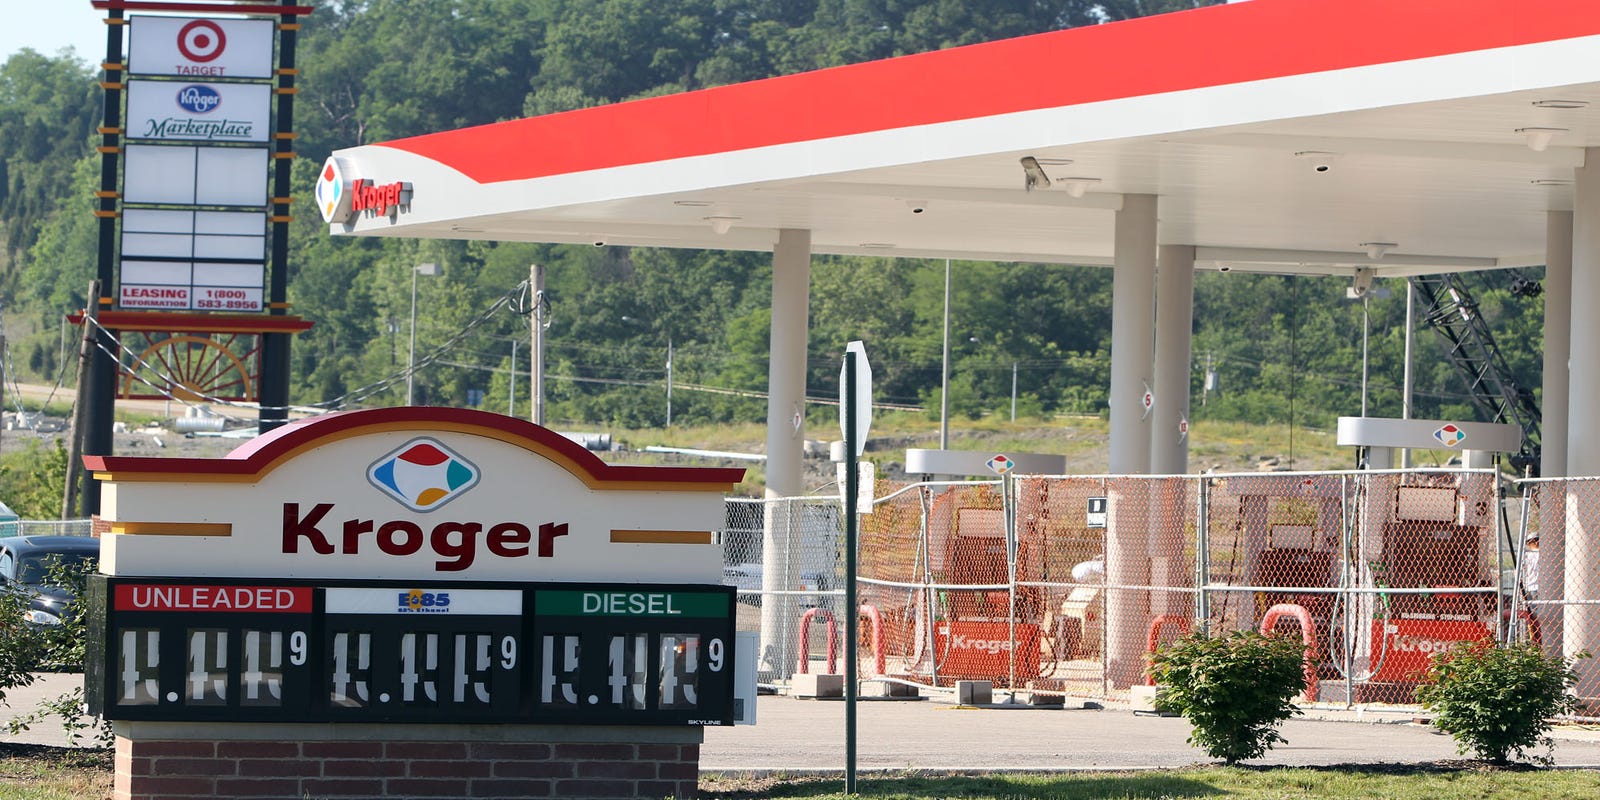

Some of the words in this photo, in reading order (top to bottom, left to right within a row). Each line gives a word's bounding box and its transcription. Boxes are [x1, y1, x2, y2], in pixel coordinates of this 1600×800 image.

[176, 65, 226, 76] TARGET
[181, 88, 219, 112] Kroger
[144, 118, 253, 139] Marketplace
[352, 178, 403, 217] Kroger
[122, 288, 187, 298] LEASING
[122, 299, 187, 307] INFORMATION
[206, 289, 246, 299] 1(800)
[197, 299, 258, 309] 583-8956
[282, 502, 569, 572] Kroger
[133, 587, 295, 609] UNLEADED
[583, 593, 682, 614] DIESEL
[290, 631, 307, 666] 9
[501, 635, 517, 670] 9
[708, 638, 724, 672] 9
